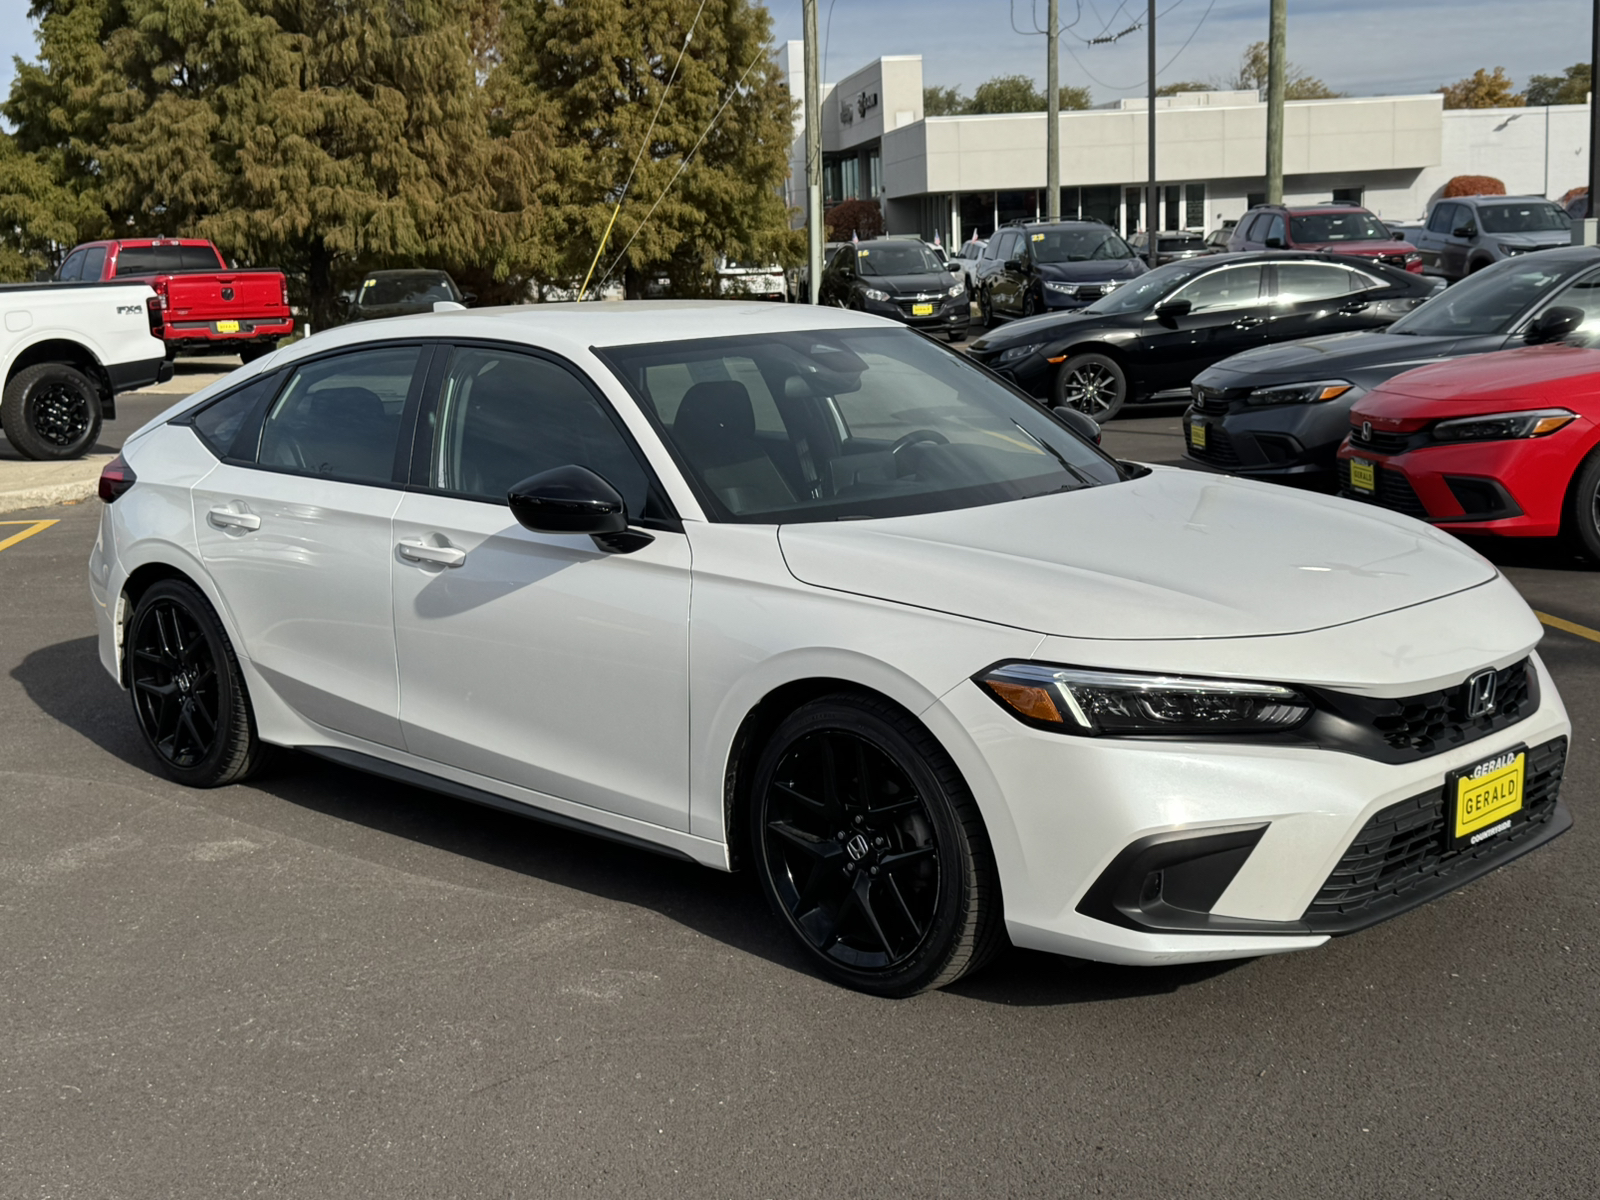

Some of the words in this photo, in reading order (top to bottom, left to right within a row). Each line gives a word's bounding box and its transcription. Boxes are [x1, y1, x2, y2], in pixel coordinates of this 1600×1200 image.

[1354, 469, 1372, 482] GERALD
[1473, 752, 1515, 779] GERALD
[1465, 779, 1515, 815] GERALD
